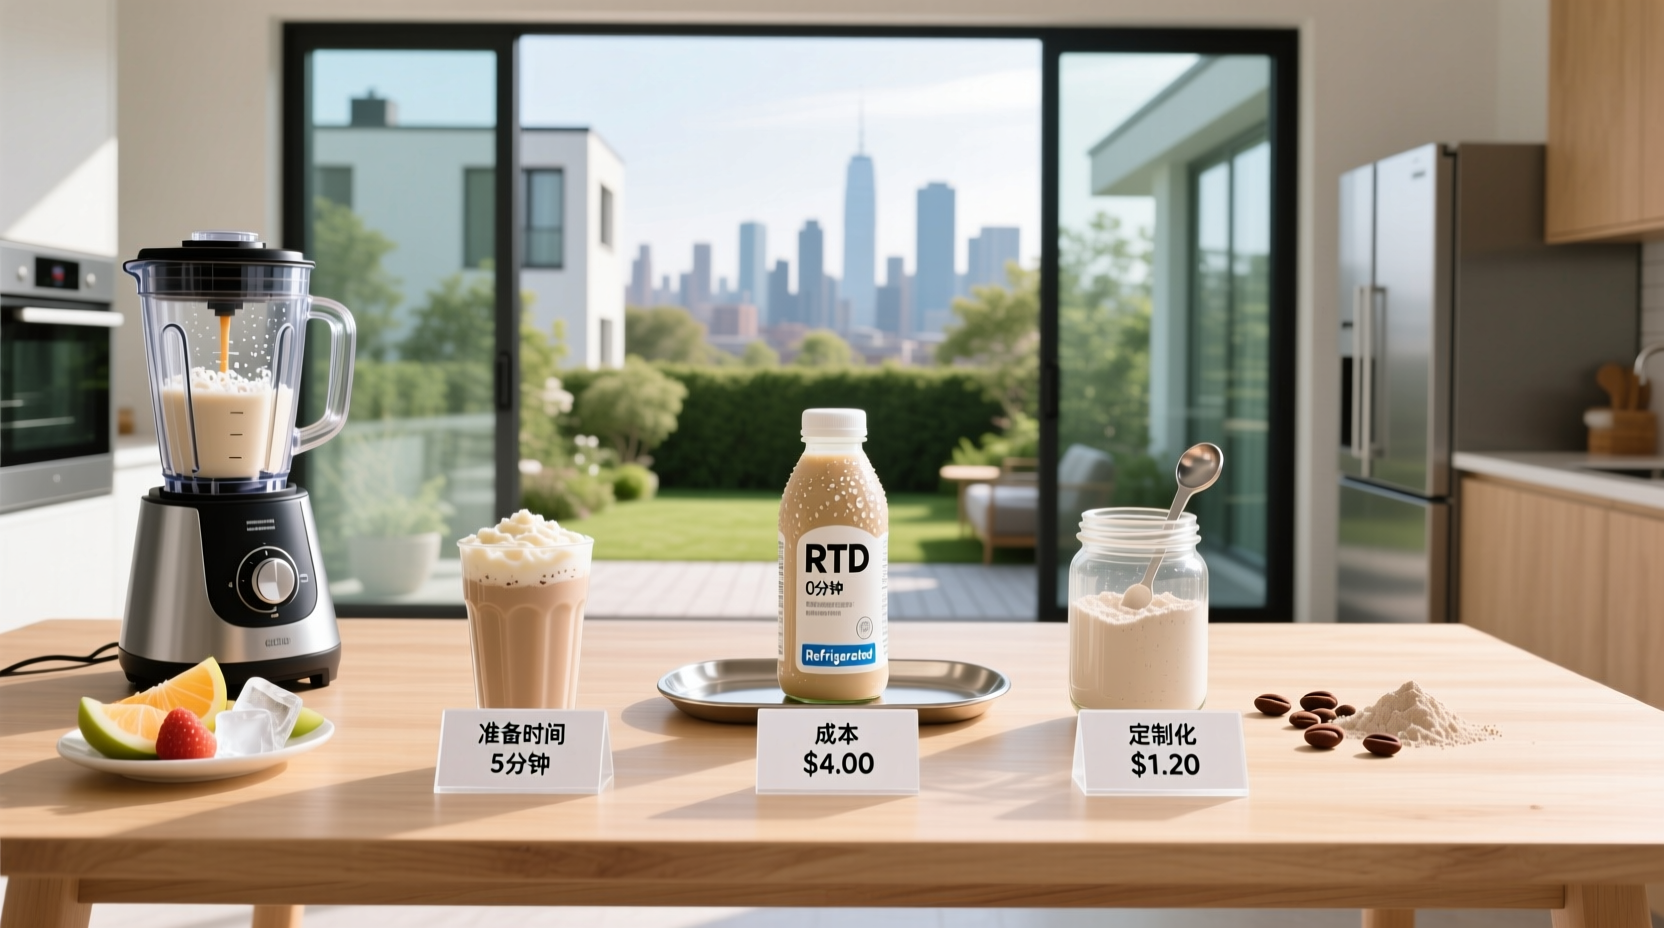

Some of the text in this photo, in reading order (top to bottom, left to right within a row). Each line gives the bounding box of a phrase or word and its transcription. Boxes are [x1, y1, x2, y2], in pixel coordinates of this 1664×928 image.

[805, 543, 870, 573] RTD
[478, 721, 566, 746] 准备时间
[815, 722, 859, 745] 成本
[1129, 722, 1197, 746] 定制化
[490, 751, 550, 776] 5分钟
[803, 750, 875, 778] $4.00
[1131, 751, 1200, 778] $1.20
